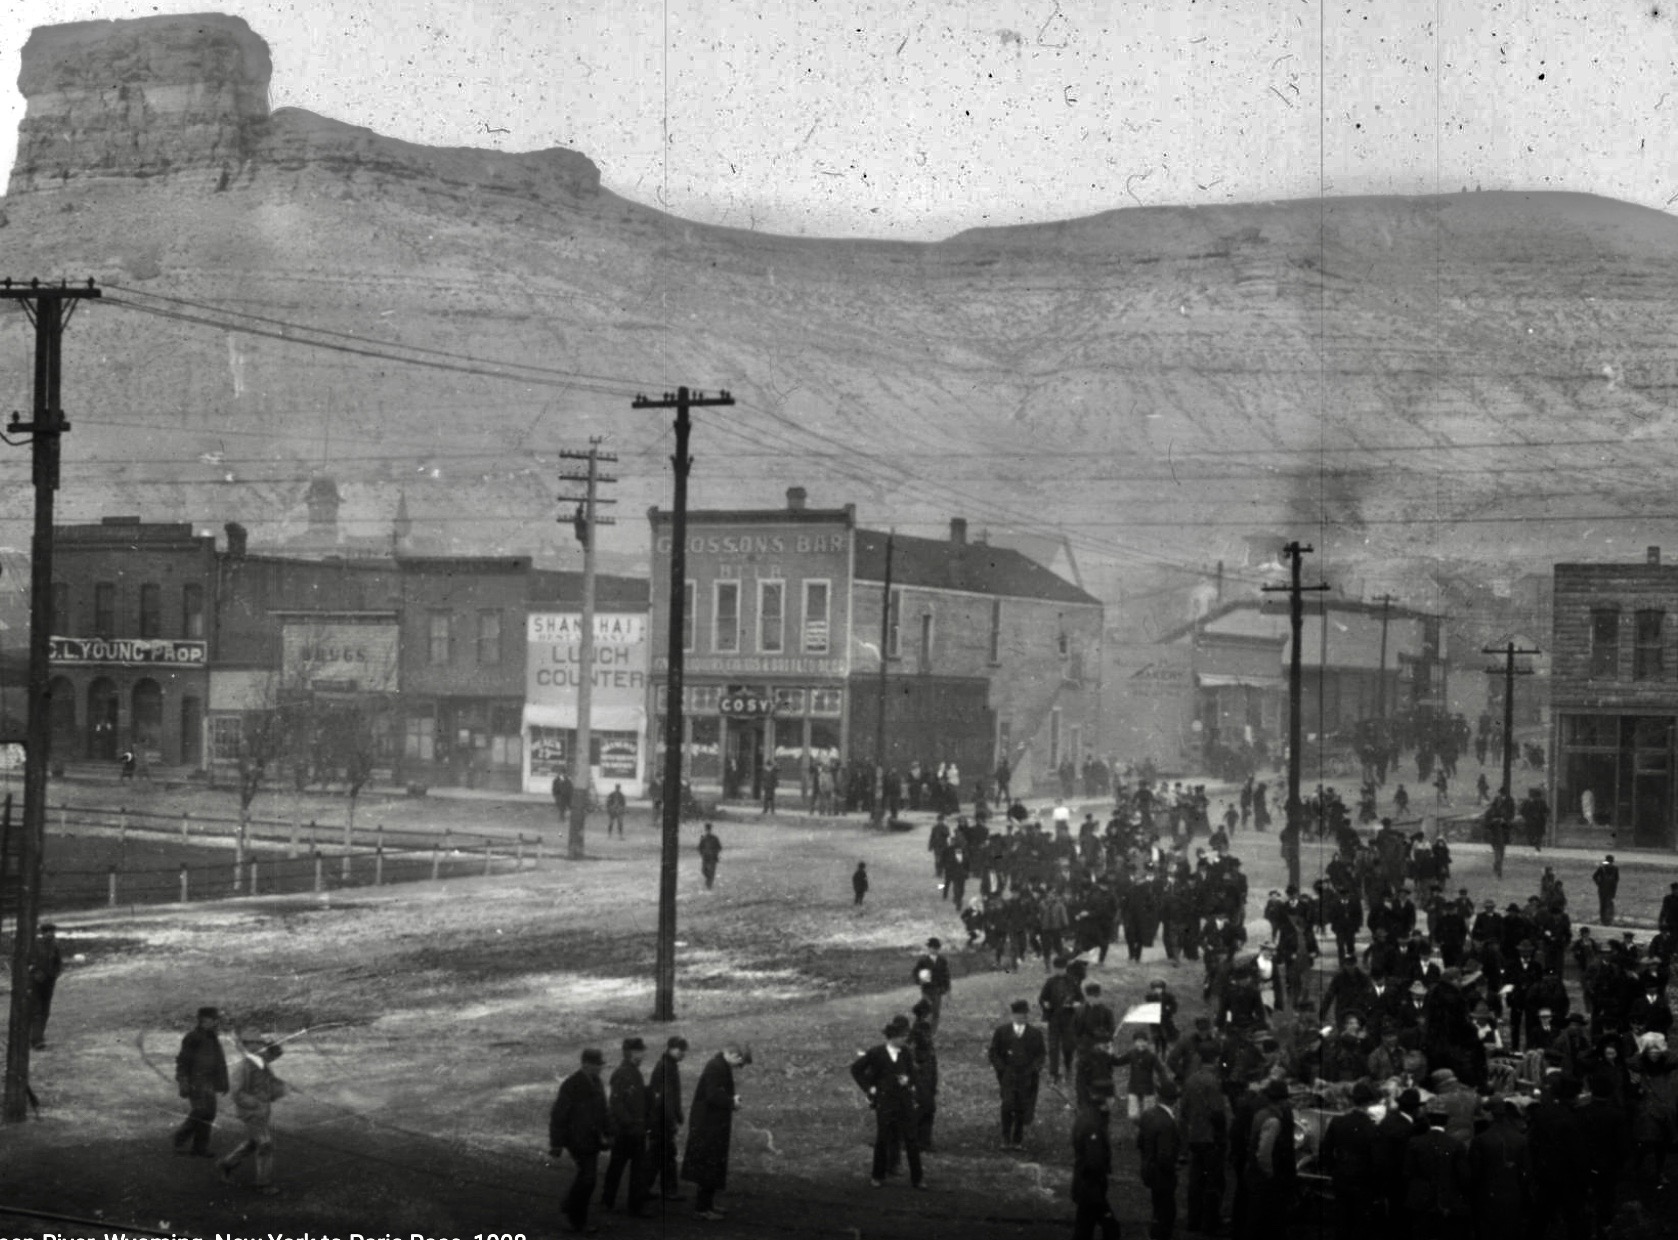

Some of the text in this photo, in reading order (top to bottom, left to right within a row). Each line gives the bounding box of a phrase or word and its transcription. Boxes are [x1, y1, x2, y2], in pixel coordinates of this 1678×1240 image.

[657, 534, 845, 553] GOSSONS BAR
[534, 616, 631, 634] SHANHAI
[721, 698, 769, 712] COSY
